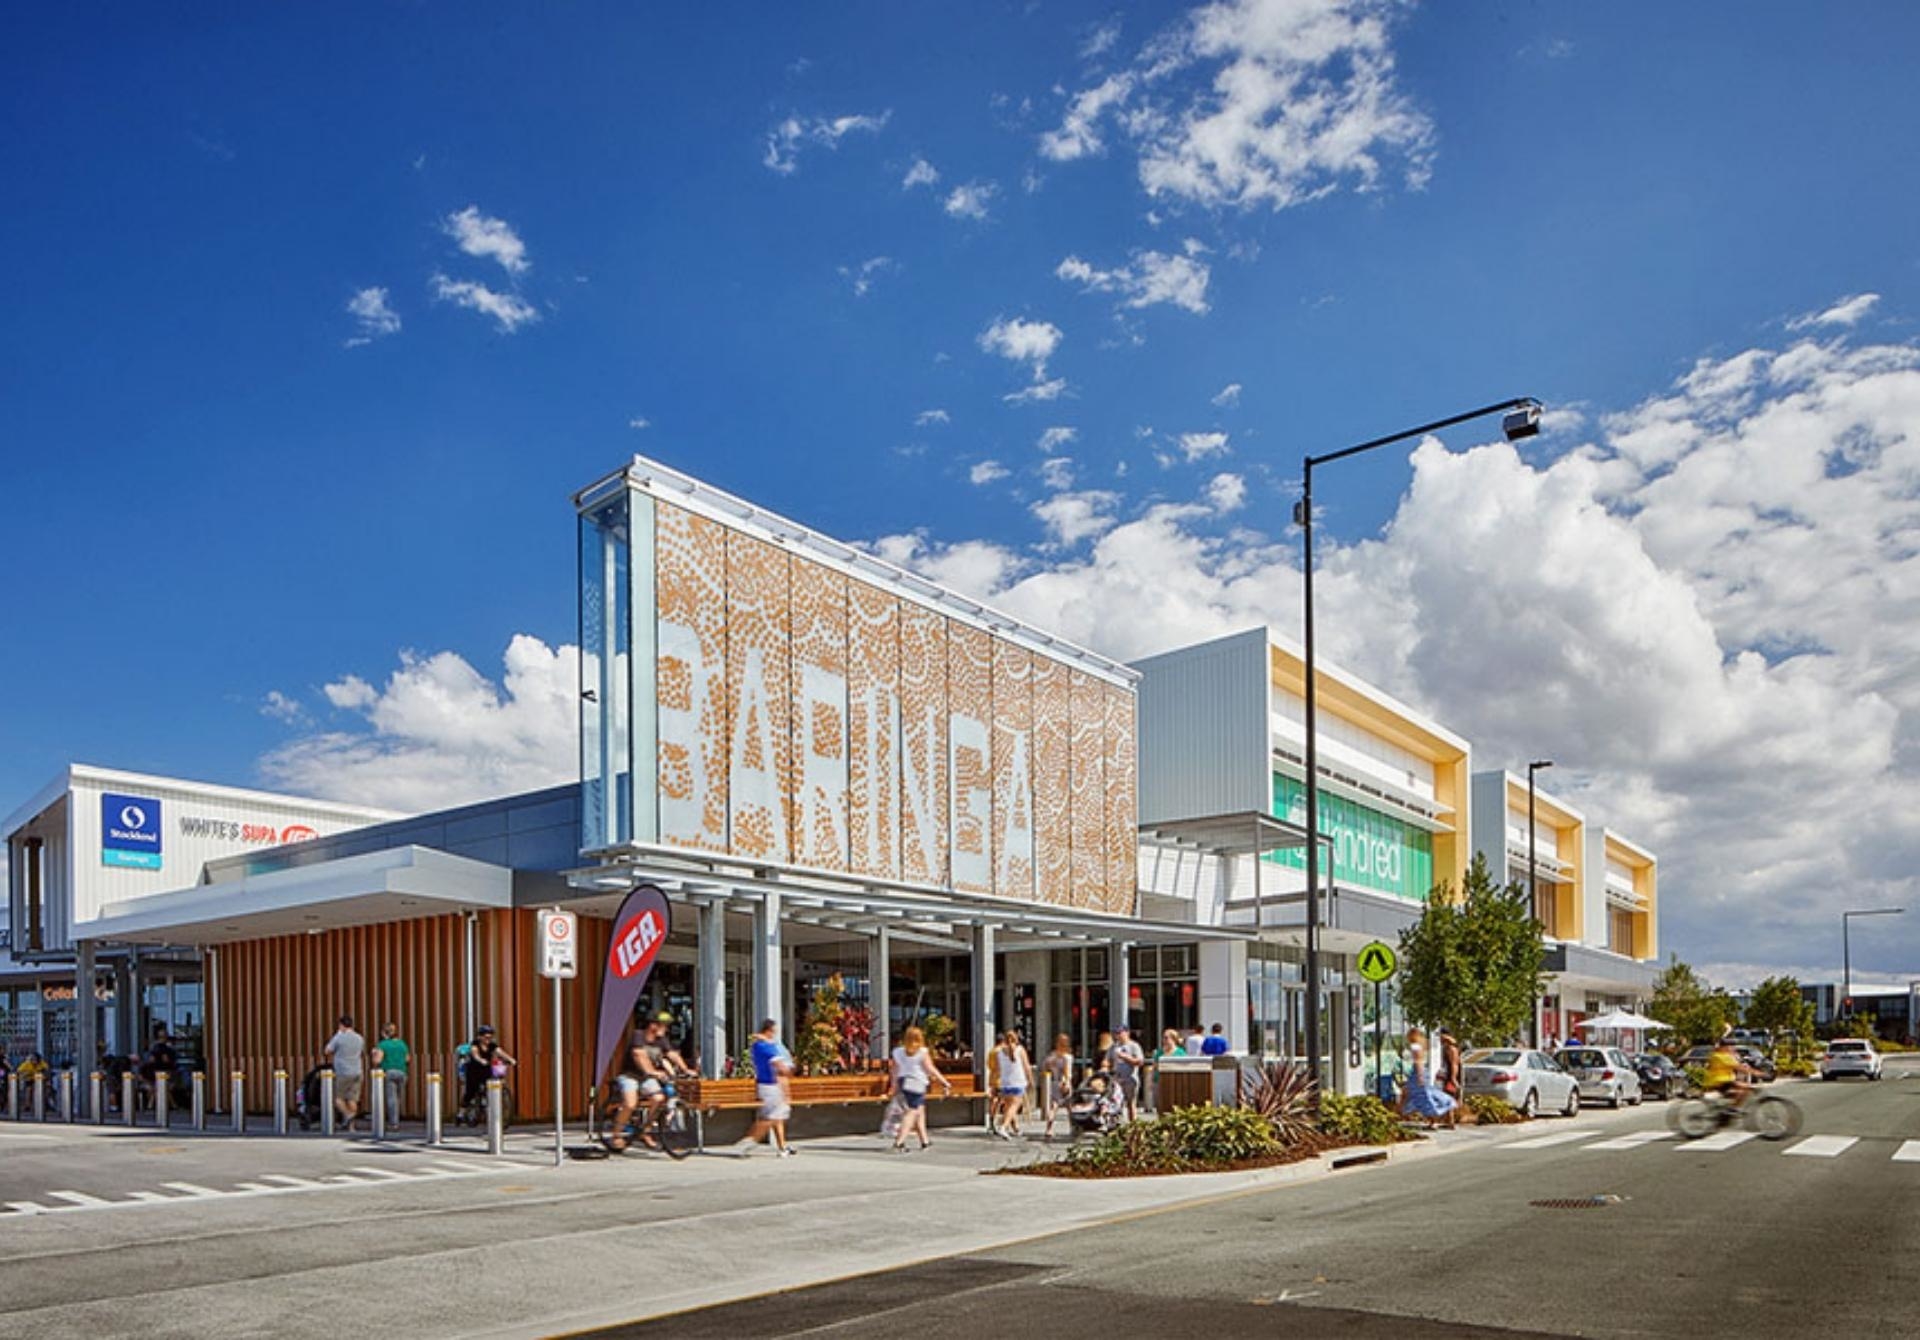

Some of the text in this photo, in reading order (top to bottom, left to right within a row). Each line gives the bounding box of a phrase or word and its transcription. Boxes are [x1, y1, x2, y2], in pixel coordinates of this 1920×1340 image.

[660, 621, 1034, 898] BARINGA
[180, 817, 239, 841] WHITE'S
[241, 823, 277, 842] SUPA
[617, 911, 658, 977] IGA
